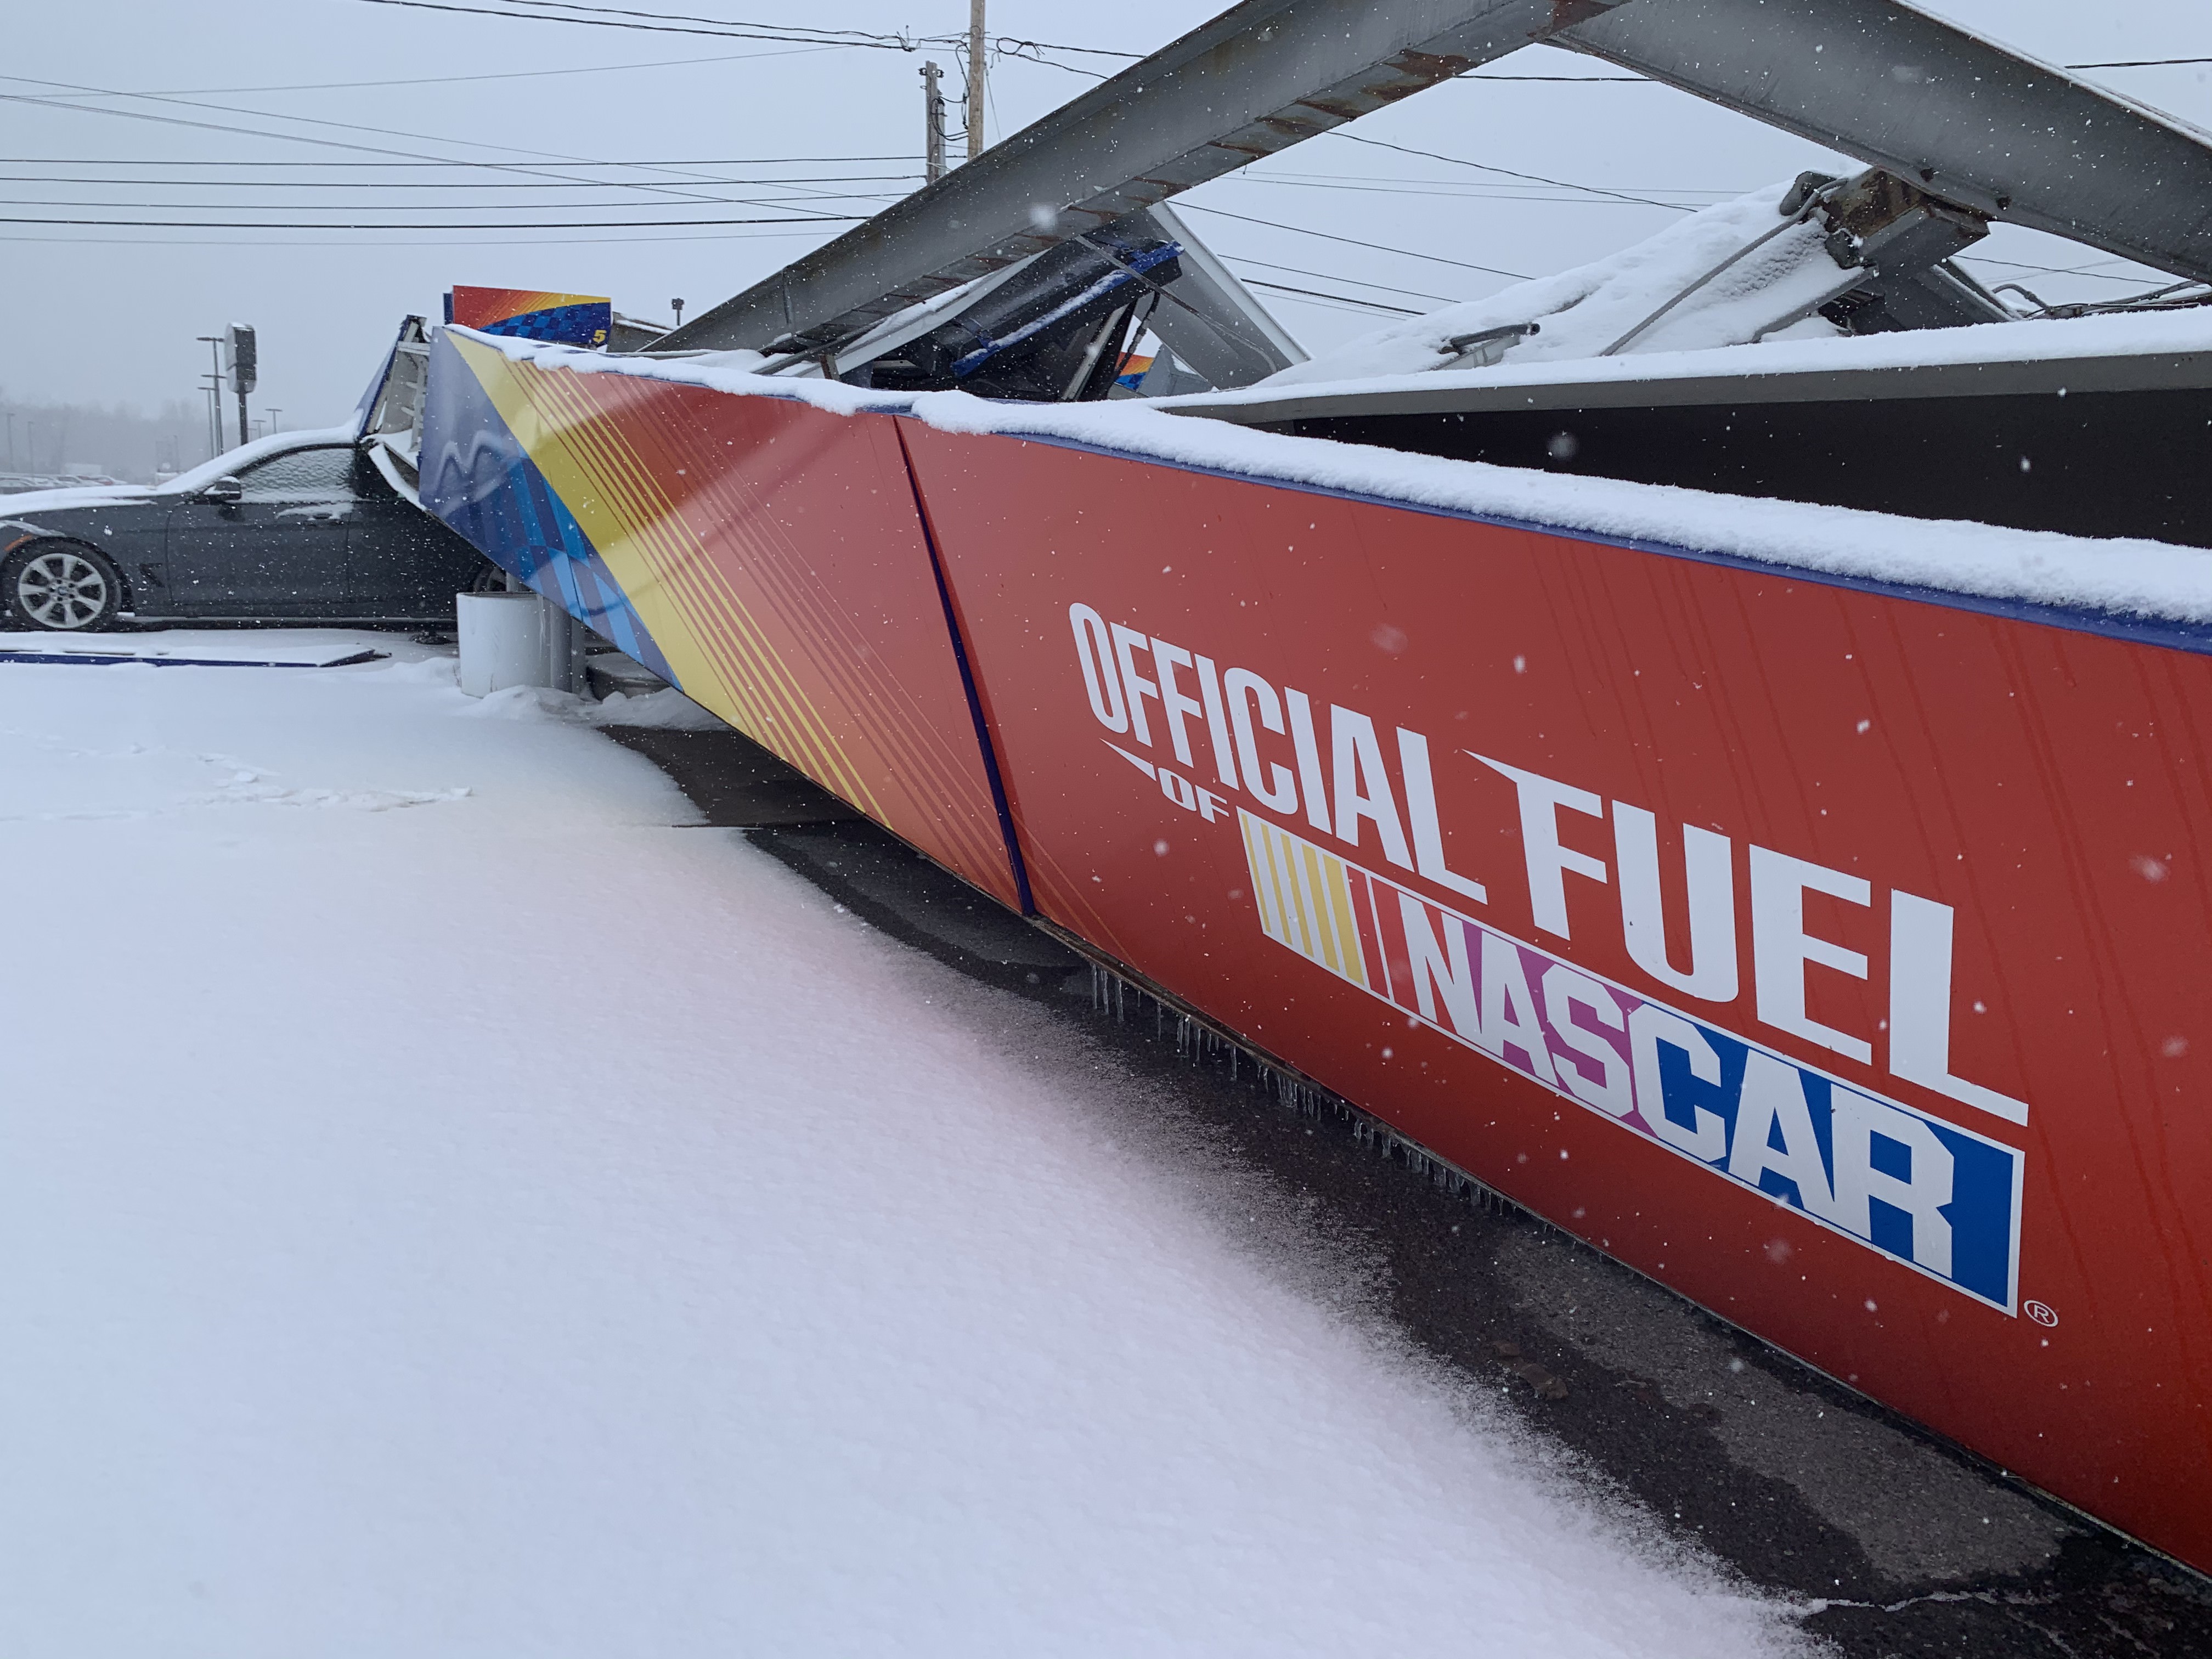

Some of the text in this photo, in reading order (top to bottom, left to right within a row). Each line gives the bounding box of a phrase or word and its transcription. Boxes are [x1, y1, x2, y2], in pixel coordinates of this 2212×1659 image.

[593, 329, 607, 343] 5
[1069, 602, 2029, 1127] OFFICIAL FUEL
[1158, 767, 1230, 824] OF
[1397, 891, 1955, 1279] NASCAR
